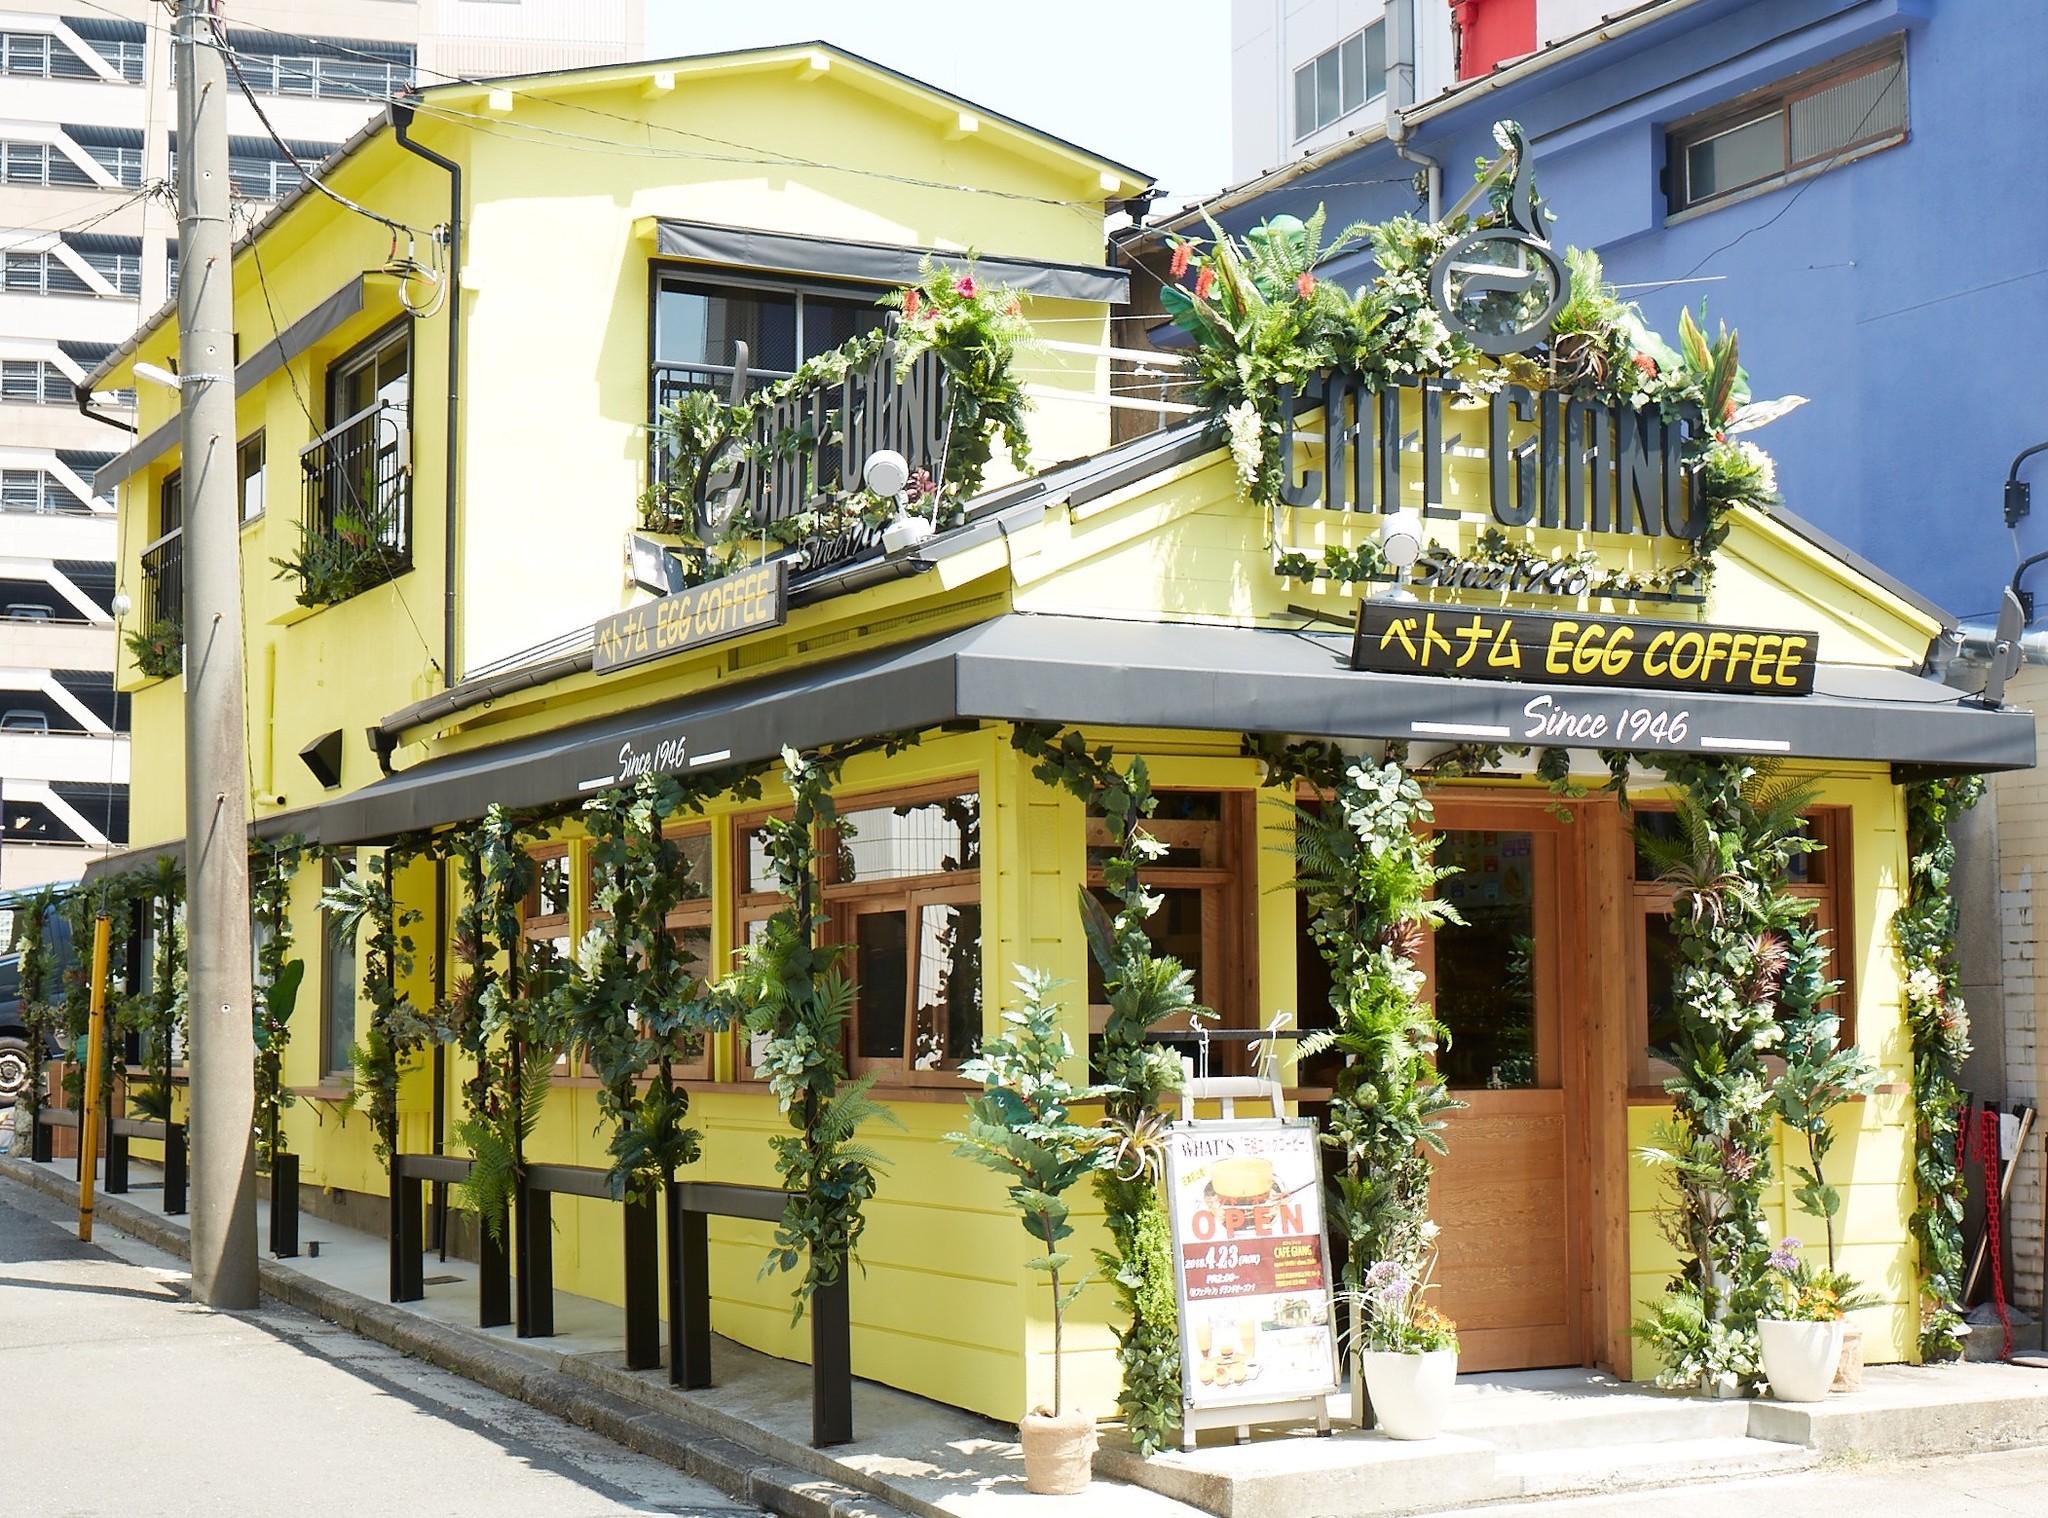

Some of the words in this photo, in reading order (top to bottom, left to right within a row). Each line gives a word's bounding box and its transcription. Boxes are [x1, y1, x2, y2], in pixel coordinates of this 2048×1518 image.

[1278, 370, 1461, 520] CAFE
[1489, 384, 1708, 541] GIANG
[598, 612, 649, 663] ベトナム
[656, 595, 692, 649] EGG
[695, 570, 770, 635] COFFEE
[1380, 613, 1521, 668] ベトナム
[1545, 621, 1635, 676] EGG
[1643, 630, 1808, 687] COFFEE
[1523, 695, 1610, 738] Since
[1616, 709, 1690, 745] 1946
[619, 741, 653, 781] Since
[654, 736, 686, 771] 1946
[1181, 1138, 1235, 1157] WHAT'S
[1191, 1204, 1304, 1240] OPEN
